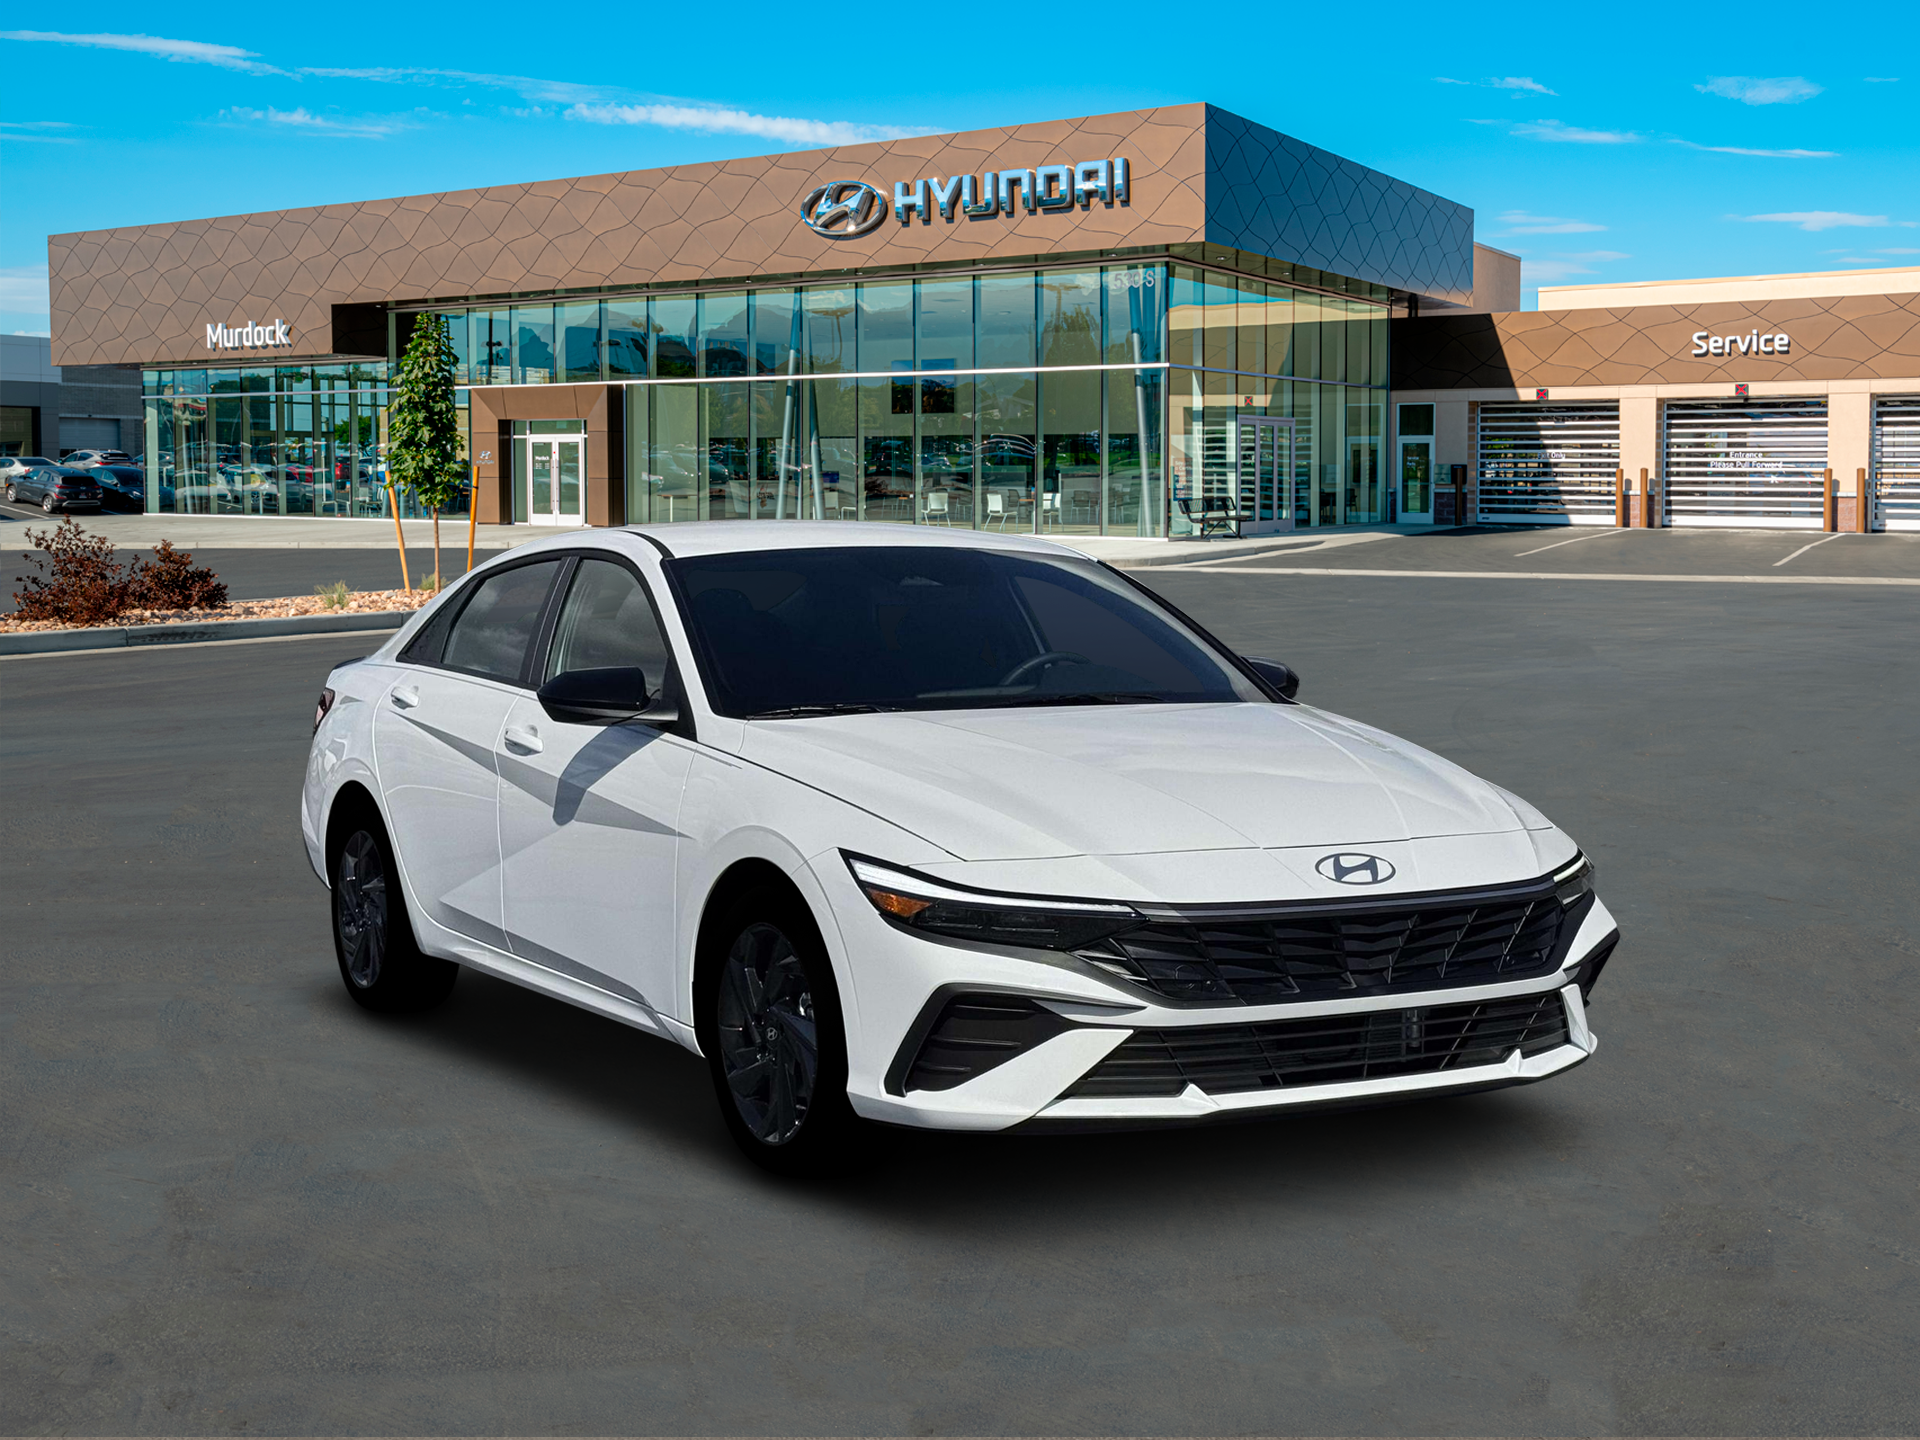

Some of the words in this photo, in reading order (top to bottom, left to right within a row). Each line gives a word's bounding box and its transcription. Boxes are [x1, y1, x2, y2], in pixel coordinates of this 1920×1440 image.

[894, 157, 1129, 223] HYUNDAI
[1114, 271, 1141, 289] 530
[1145, 270, 1155, 287] S
[206, 318, 291, 349] Murdock
[1691, 329, 1790, 356] Service
[1537, 451, 1550, 460] Exit
[1551, 451, 1566, 460] Only
[1710, 460, 1734, 468] Please
[1735, 460, 1750, 468] Pull
[1751, 460, 1783, 468] Forward
[1729, 451, 1763, 459] Entrance
